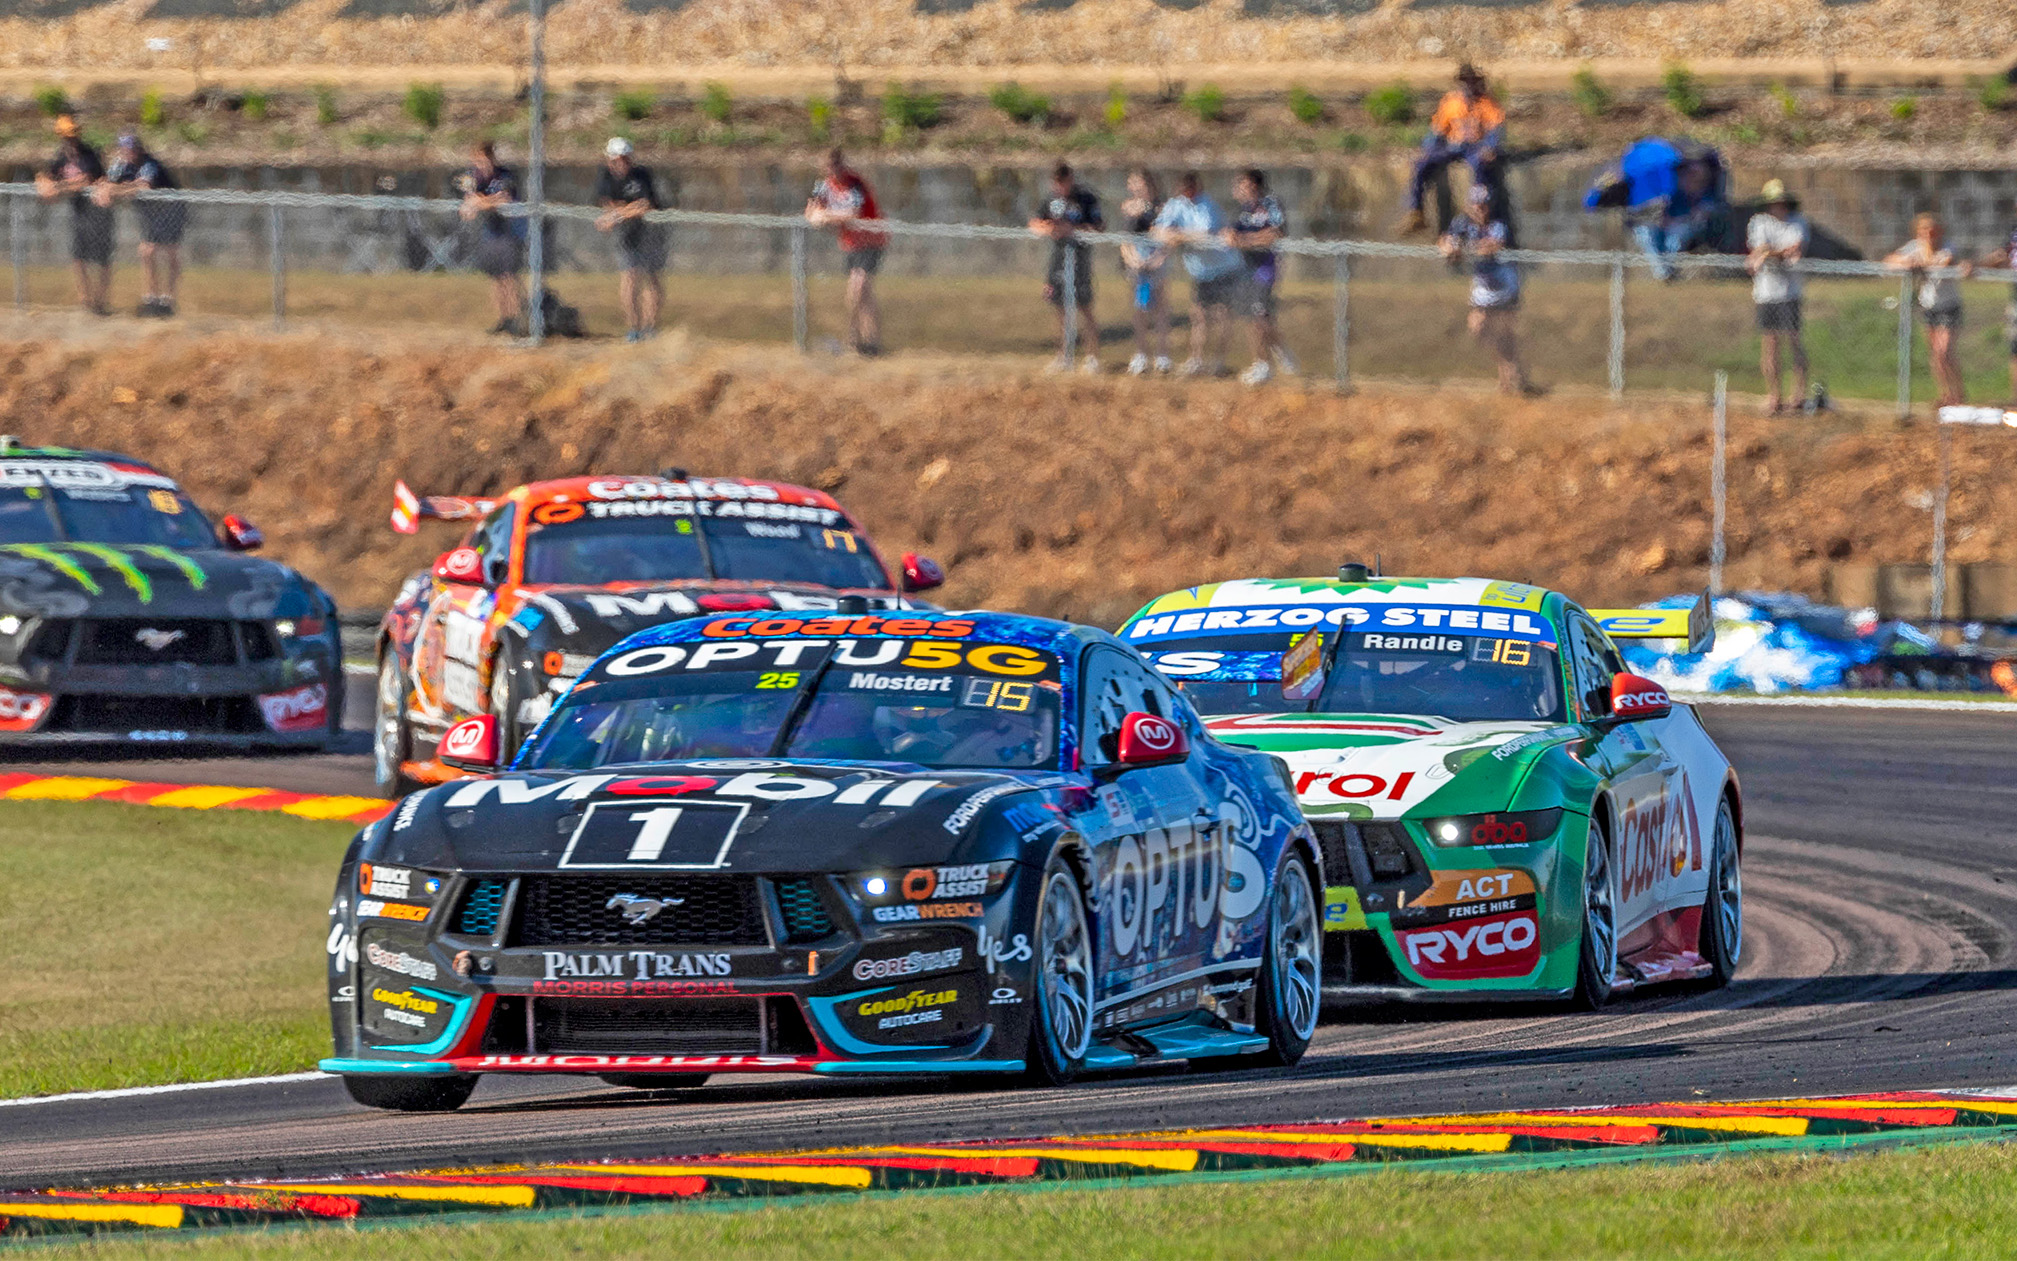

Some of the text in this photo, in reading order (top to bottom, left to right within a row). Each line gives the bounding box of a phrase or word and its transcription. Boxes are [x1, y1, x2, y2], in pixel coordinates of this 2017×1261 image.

[702, 616, 978, 638] Coates
[1129, 607, 1542, 639] HERZOG STEEL
[1364, 632, 1464, 653] Randle
[755, 672, 801, 690] 25
[849, 671, 953, 693] Mostert
[1614, 691, 1670, 709] RYCO
[444, 772, 942, 808] Mobil
[627, 808, 683, 860] 1
[937, 863, 990, 882] TRUCK
[932, 879, 988, 899] ASSIST
[1456, 873, 1514, 900] ACT
[872, 902, 985, 923] GEARWRENCH
[1448, 899, 1517, 918] FENCE HIRE
[1406, 917, 1537, 965] RYCO
[542, 951, 732, 980] PALM TRANS
[533, 980, 740, 994] MORRIS PERSONAL
[858, 989, 958, 1017] GOODYEAR
[878, 1009, 942, 1030] AUTOCARE
